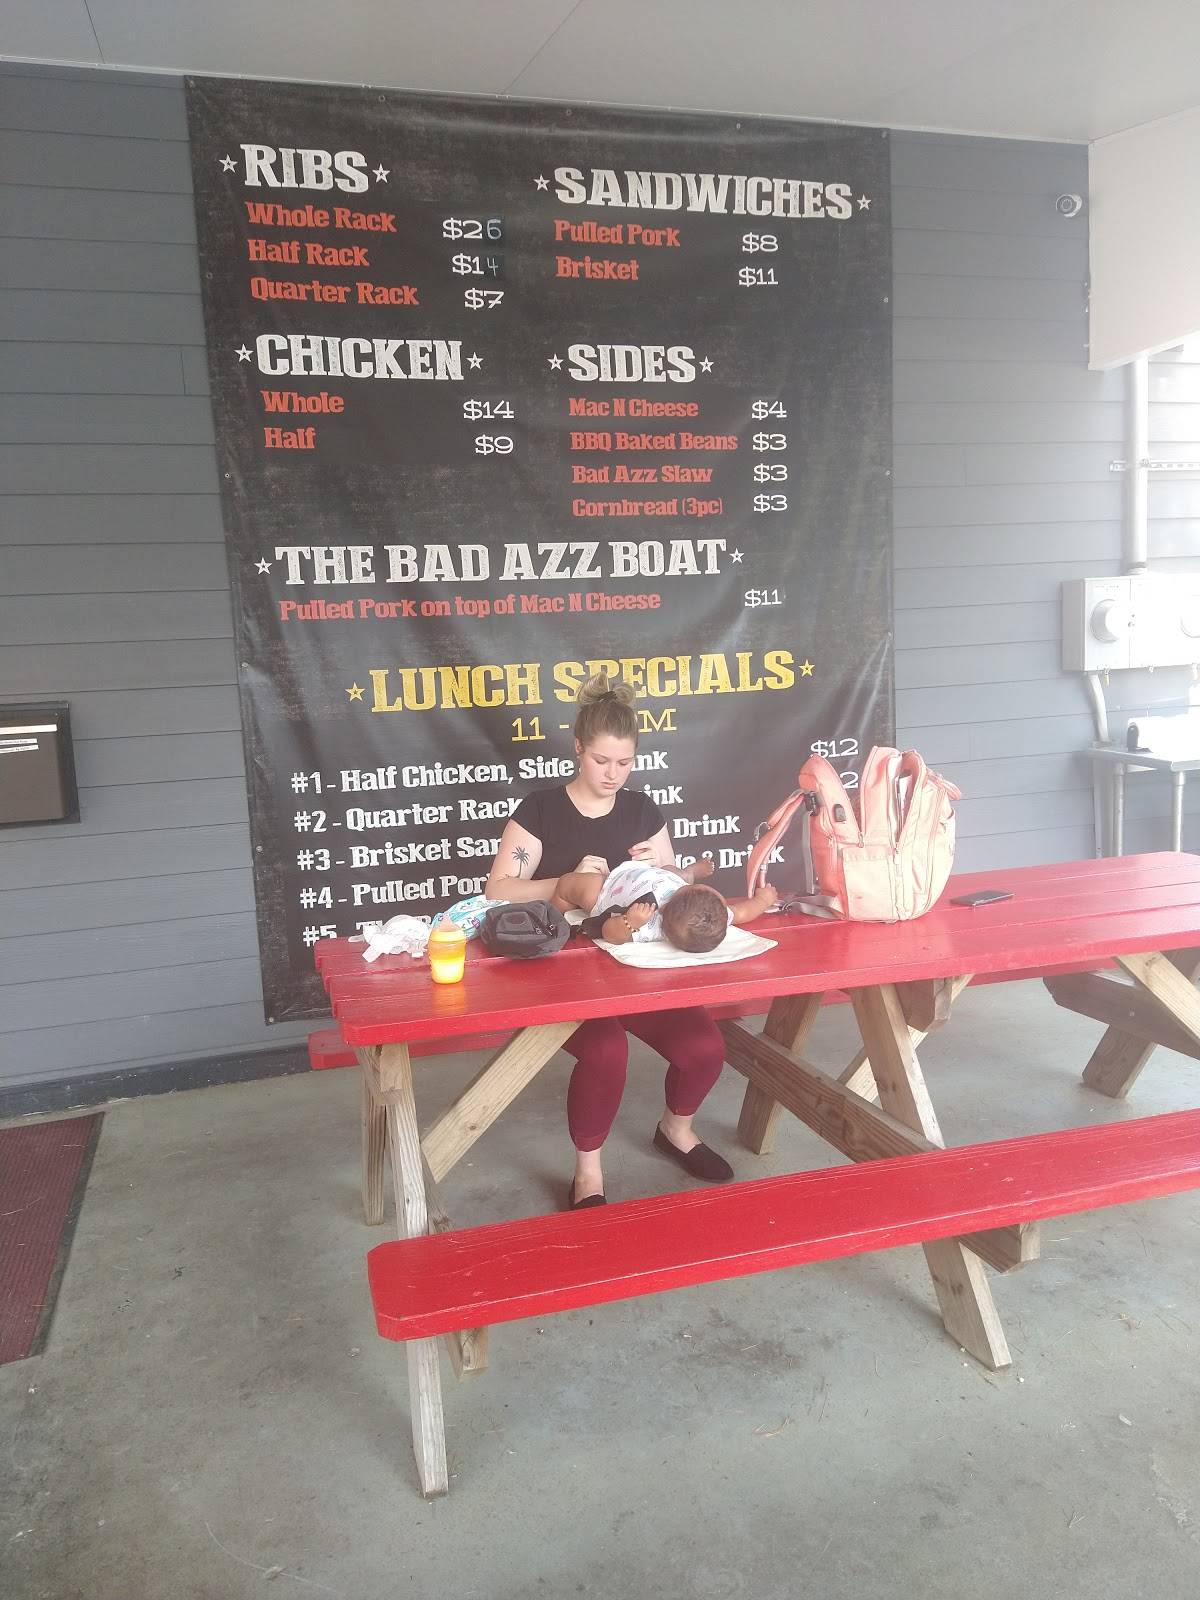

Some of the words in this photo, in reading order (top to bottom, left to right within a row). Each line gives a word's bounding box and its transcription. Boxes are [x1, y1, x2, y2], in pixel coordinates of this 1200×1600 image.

[240, 144, 369, 193] RIBS
[554, 167, 852, 220] SANDWICHES
[245, 202, 329, 229] Whole
[334, 207, 397, 232] Rack
[443, 217, 502, 240] $26
[554, 219, 622, 245] Pulled
[627, 223, 681, 247] Pork
[742, 232, 779, 254] $8
[248, 239, 300, 264] Half
[306, 242, 370, 267] Rack
[452, 253, 499, 276] $14
[555, 256, 639, 281] Brisket
[738, 266, 779, 287] $11
[251, 277, 350, 303] Quarter
[356, 282, 420, 305] Rack
[464, 287, 504, 310] $7
[256, 334, 464, 381] CHICKEN
[568, 344, 696, 383] SIDES
[261, 390, 345, 413] Whole
[463, 399, 514, 421] $14
[568, 397, 610, 417] Mac
[613, 398, 625, 417] N
[629, 398, 699, 417] Cheese
[751, 399, 787, 421] $4
[264, 427, 316, 449] Half
[475, 434, 514, 456] $9
[570, 432, 611, 452] BBQ
[615, 432, 675, 451] Baked
[680, 433, 738, 451] Beans
[752, 432, 787, 453] $3
[572, 465, 609, 484] Bad
[615, 465, 658, 484] Azz
[661, 466, 713, 484] Slaw
[753, 463, 788, 484] $3
[572, 498, 677, 518] Cornbread
[682, 497, 723, 516] (3pc)
[753, 493, 788, 514] $3
[275, 545, 376, 585] THE
[384, 544, 490, 583] BAD
[499, 541, 601, 581] AZZ
[608, 539, 726, 578] BOAT
[279, 598, 354, 622] Pulled
[358, 597, 417, 618] Pork
[421, 599, 451, 616] on
[455, 596, 490, 618] top
[494, 593, 515, 614] of
[520, 592, 565, 614] Mac
[569, 592, 583, 612] N
[585, 591, 661, 612] Cheese
[745, 588, 782, 608] $11
[369, 663, 543, 713] LUNCH
[553, 650, 795, 703] SPECIALS
[511, 716, 546, 740] 11
[291, 771, 322, 794] #1
[340, 766, 397, 793] Half
[402, 762, 514, 788] Chicken,
[519, 755, 575, 779] Side
[810, 738, 859, 758] $12
[294, 810, 327, 833] #2
[346, 803, 453, 831] Quarter
[297, 848, 331, 871] #3
[349, 838, 451, 869] Brisket
[673, 813, 740, 839] Drink
[300, 886, 333, 909] #4
[351, 878, 434, 906] Pulled
[439, 874, 490, 897] Por
[718, 845, 784, 869] Drik
